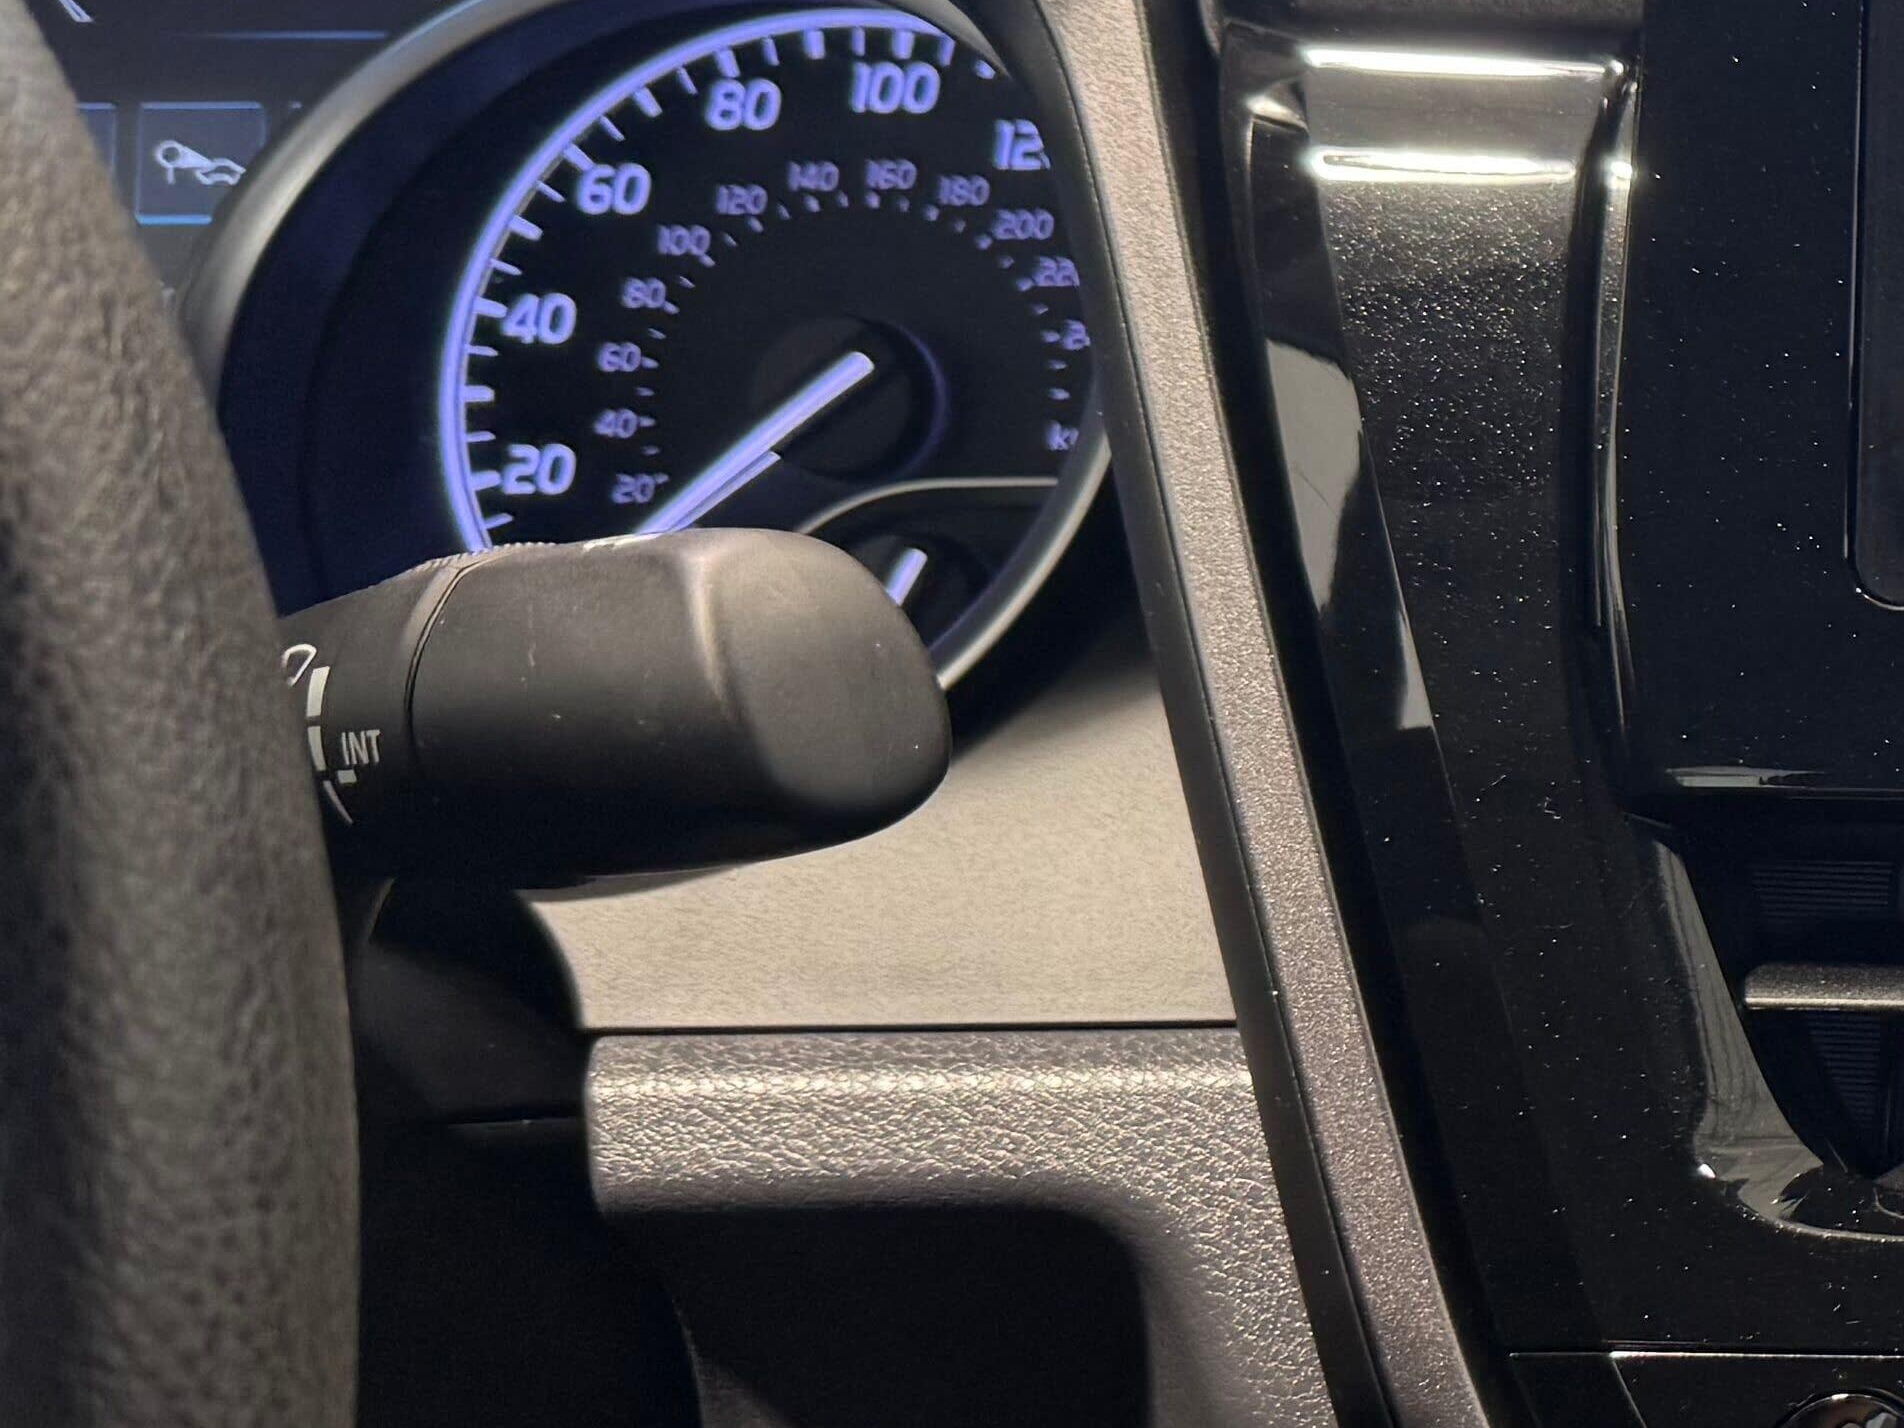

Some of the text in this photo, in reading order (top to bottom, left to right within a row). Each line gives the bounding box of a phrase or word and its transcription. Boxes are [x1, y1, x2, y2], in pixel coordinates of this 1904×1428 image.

[705, 78, 781, 131] 80
[850, 61, 941, 114] 100
[993, 119, 1051, 171] 12
[576, 162, 652, 216] 60
[716, 183, 768, 217] 120
[657, 224, 711, 258] 100
[992, 208, 1054, 242] 200
[1032, 256, 1080, 288] 22
[621, 277, 666, 311] 80
[502, 292, 577, 345] 40
[598, 341, 643, 374] 60
[593, 408, 638, 441] 40
[502, 443, 577, 496] 20
[611, 472, 655, 503] 20
[341, 729, 381, 766] INT
